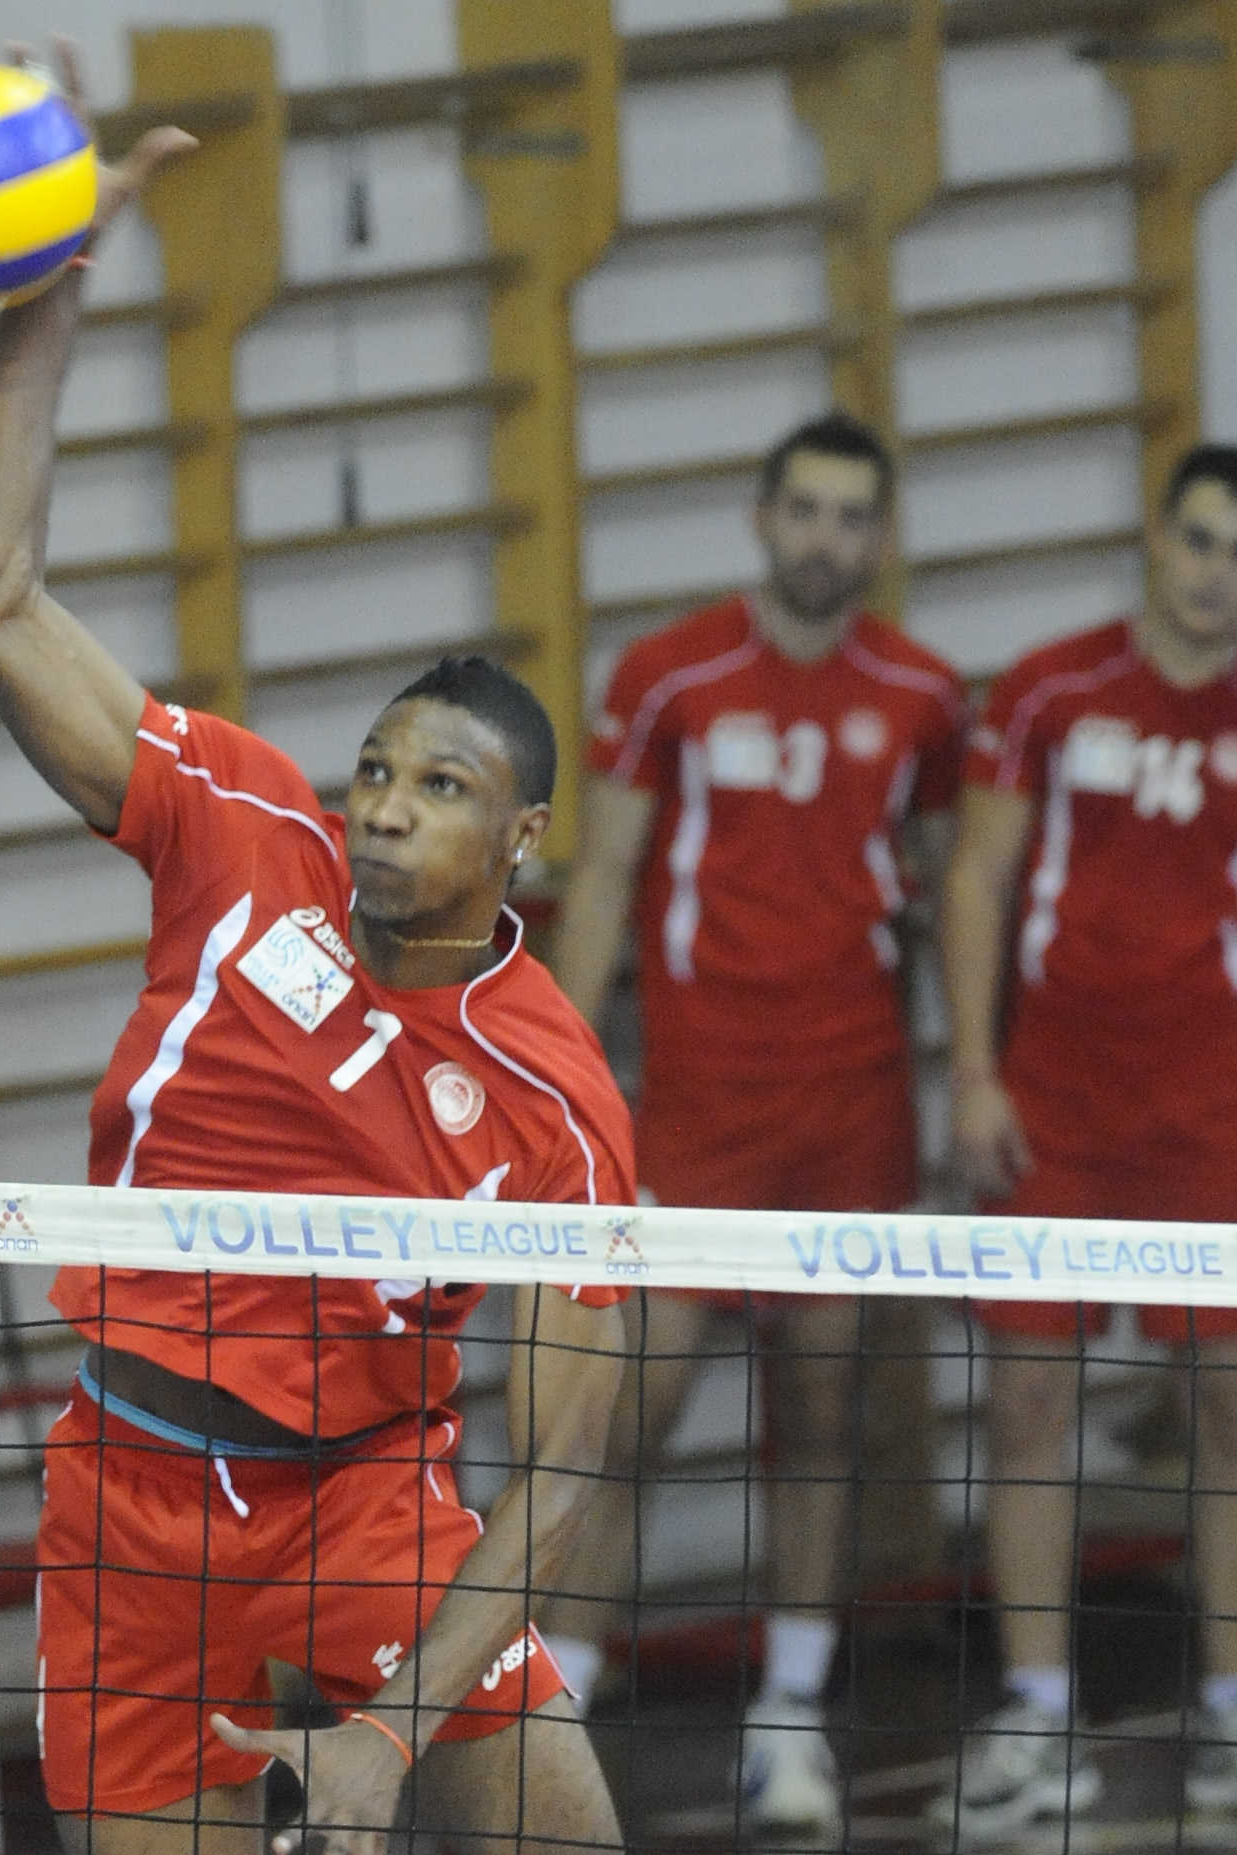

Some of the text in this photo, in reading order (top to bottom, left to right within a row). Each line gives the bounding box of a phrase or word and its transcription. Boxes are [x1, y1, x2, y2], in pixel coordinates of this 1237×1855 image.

[160, 1199, 589, 1262] VOLLEY LEAGUE
[786, 1222, 1224, 1281] VOLLEY LEAGUE
